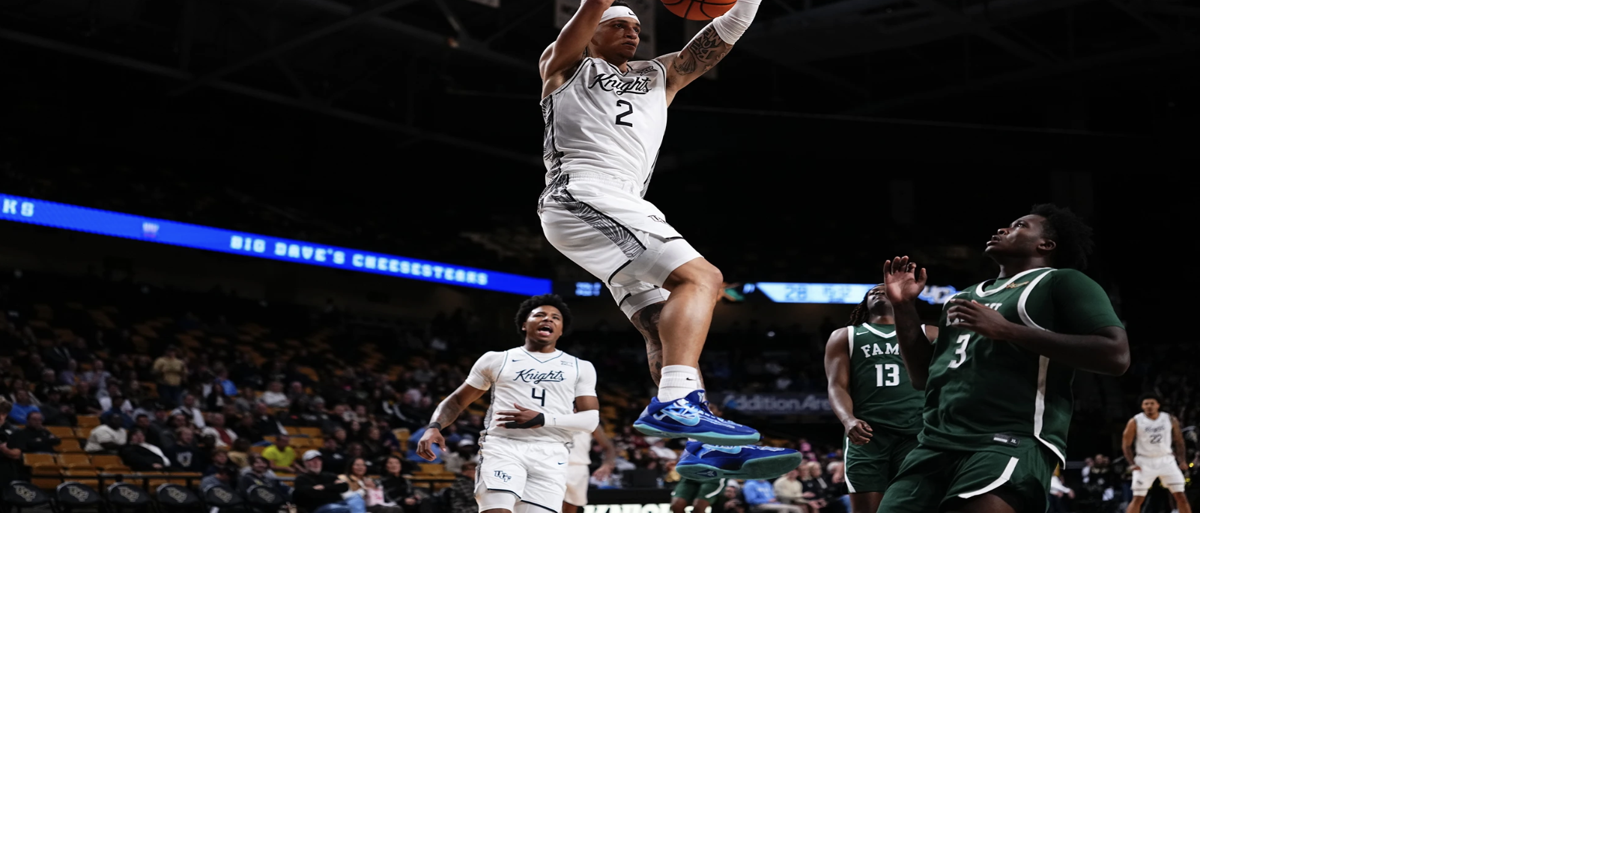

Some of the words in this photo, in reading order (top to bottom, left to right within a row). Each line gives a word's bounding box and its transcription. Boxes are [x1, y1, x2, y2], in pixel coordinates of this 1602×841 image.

[588, 74, 651, 95] Knights
[615, 99, 633, 127] 2
[230, 234, 266, 253] BIG
[274, 242, 345, 265] DAVE'S
[352, 253, 488, 286] CHEESESTEAKS
[860, 342, 900, 358] FAM
[949, 334, 970, 369] 3
[513, 368, 566, 384] Knights
[874, 363, 900, 387] 13
[532, 388, 545, 407] 4
